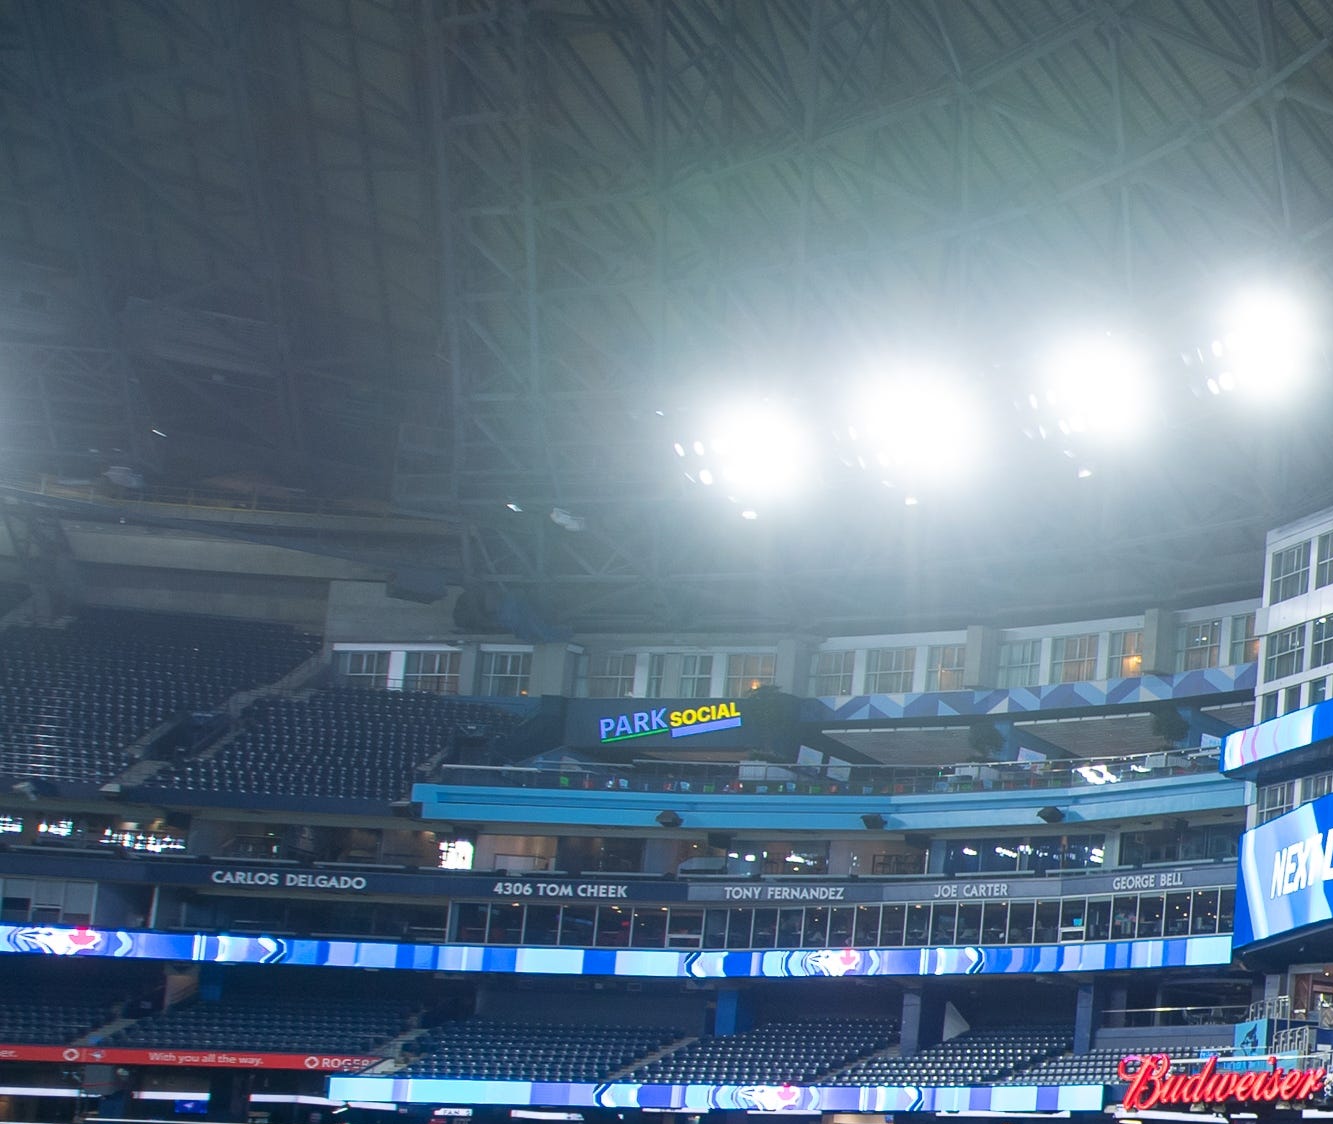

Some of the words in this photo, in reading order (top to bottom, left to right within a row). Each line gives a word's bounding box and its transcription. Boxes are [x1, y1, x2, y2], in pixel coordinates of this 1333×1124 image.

[600, 707, 669, 739] PARK
[670, 702, 741, 727] SOCIAL
[212, 870, 279, 886] CARLOS
[285, 874, 367, 890] DELGADO
[1112, 874, 1156, 890] GEORGE
[1159, 873, 1184, 887] BELL
[494, 882, 532, 896] 4306
[536, 884, 574, 898] TOM
[577, 884, 629, 898] CHEEK
[724, 886, 762, 900] TONY
[767, 887, 845, 900] FERNANDEZ
[934, 884, 959, 898] JOE
[963, 883, 1009, 897] CARTER
[149, 1052, 176, 1062] With
[178, 1054, 200, 1065] you
[201, 1053, 216, 1063] all
[217, 1054, 237, 1064] the
[238, 1056, 264, 1066] way.
[1117, 1053, 1327, 1111] Budweiser
